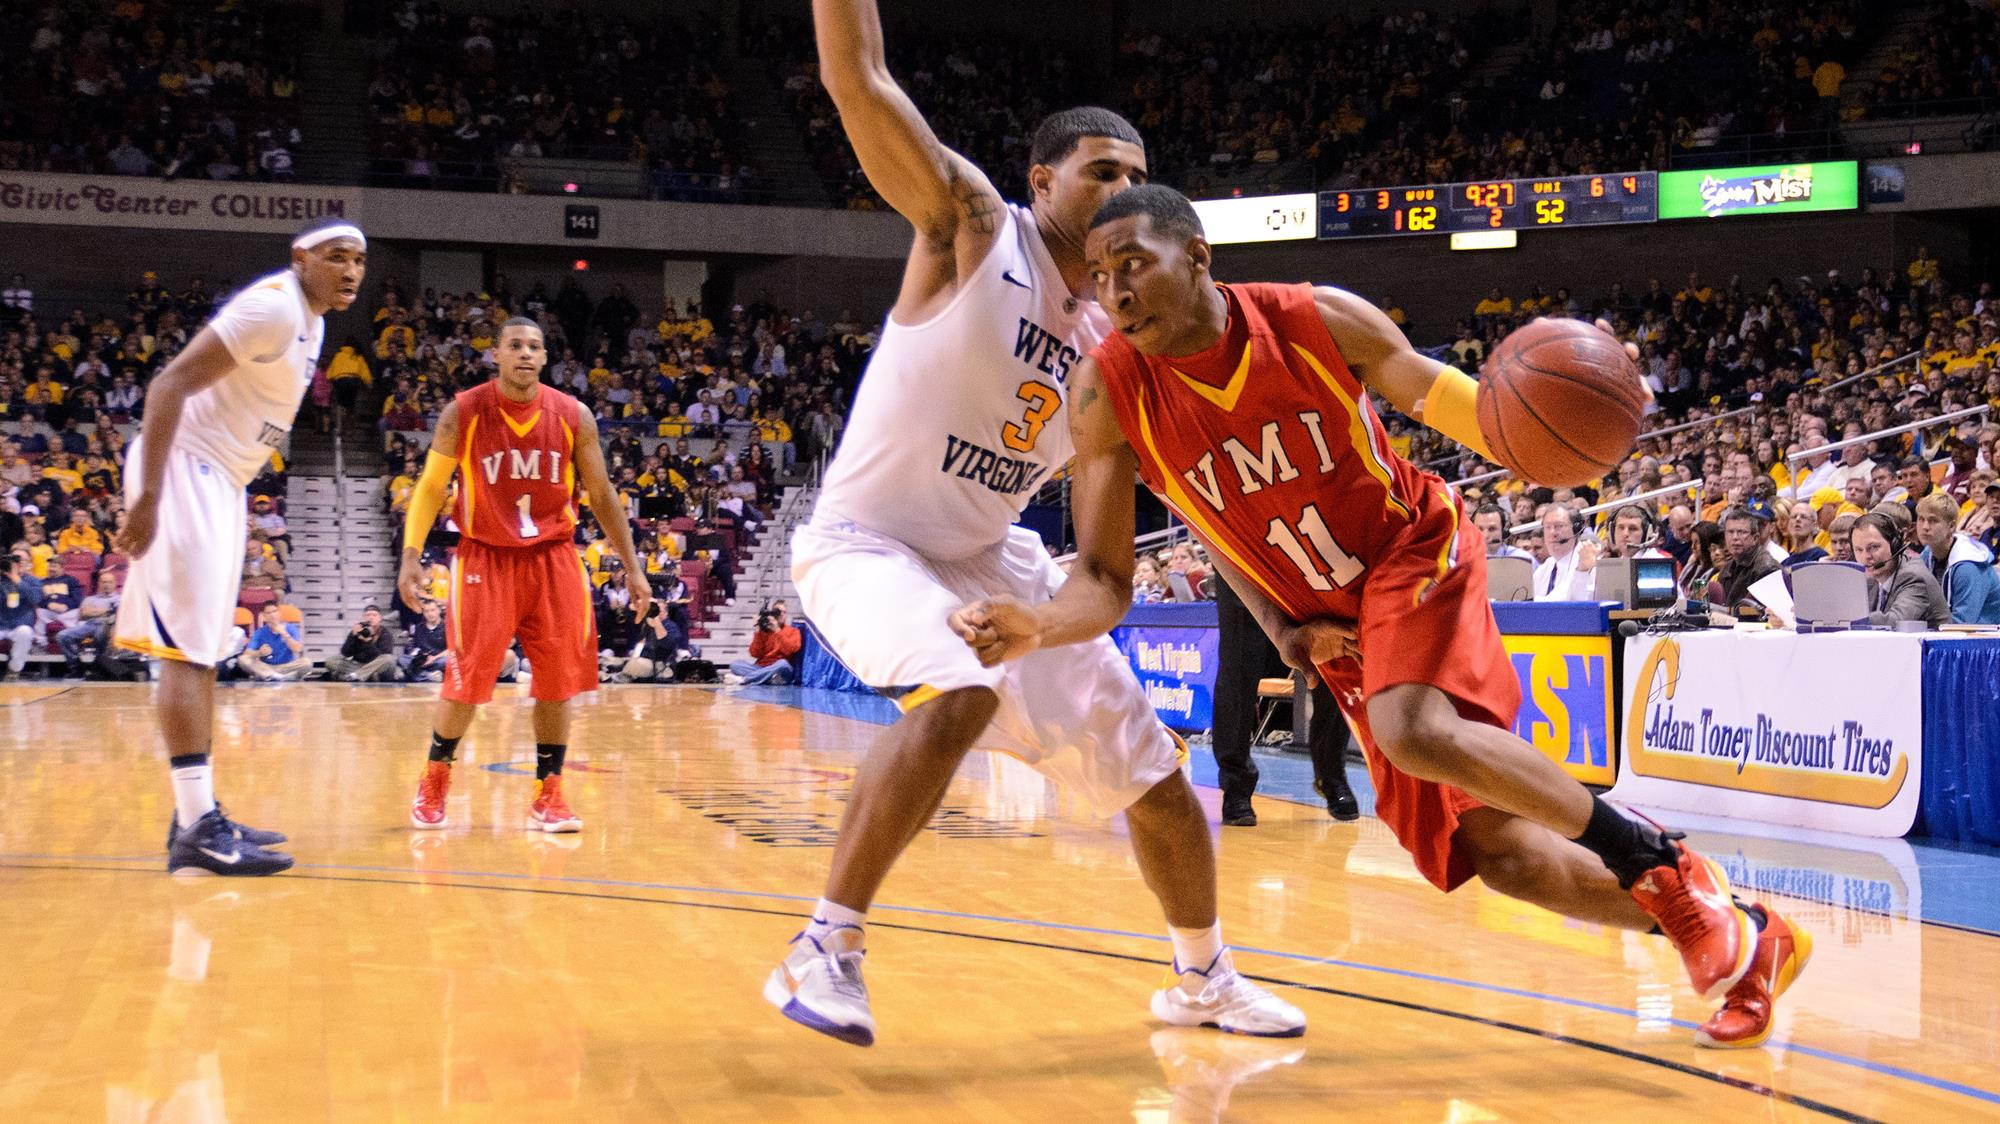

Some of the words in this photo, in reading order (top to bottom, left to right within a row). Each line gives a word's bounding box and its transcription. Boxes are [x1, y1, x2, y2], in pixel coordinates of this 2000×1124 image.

[0, 181, 80, 211] Civic
[81, 184, 199, 216] Center
[211, 193, 346, 220] COLISEUM
[1336, 192, 1350, 213] 3
[1376, 190, 1390, 210] 3
[1465, 182, 1515, 208] 9:27
[1590, 177, 1604, 198] 6
[1622, 176, 1637, 194] 4
[1751, 176, 1813, 205] Mist
[570, 215, 595, 229] 141
[1489, 207, 1503, 228] 2
[1535, 199, 1566, 225] 52
[1013, 317, 1083, 390] WES
[1001, 380, 1063, 453] 3
[481, 448, 562, 486] VMI
[1184, 411, 1335, 512] VMI
[516, 493, 539, 538] 1
[1264, 504, 1367, 592] 11
[1137, 641, 1163, 671] West
[1162, 642, 1202, 680] Virginia
[1145, 679, 1194, 720] University
[1645, 703, 1695, 752] Adam
[1700, 708, 1753, 775] Toney
[1755, 713, 1837, 770] Discount
[1843, 720, 1893, 776] Tires
